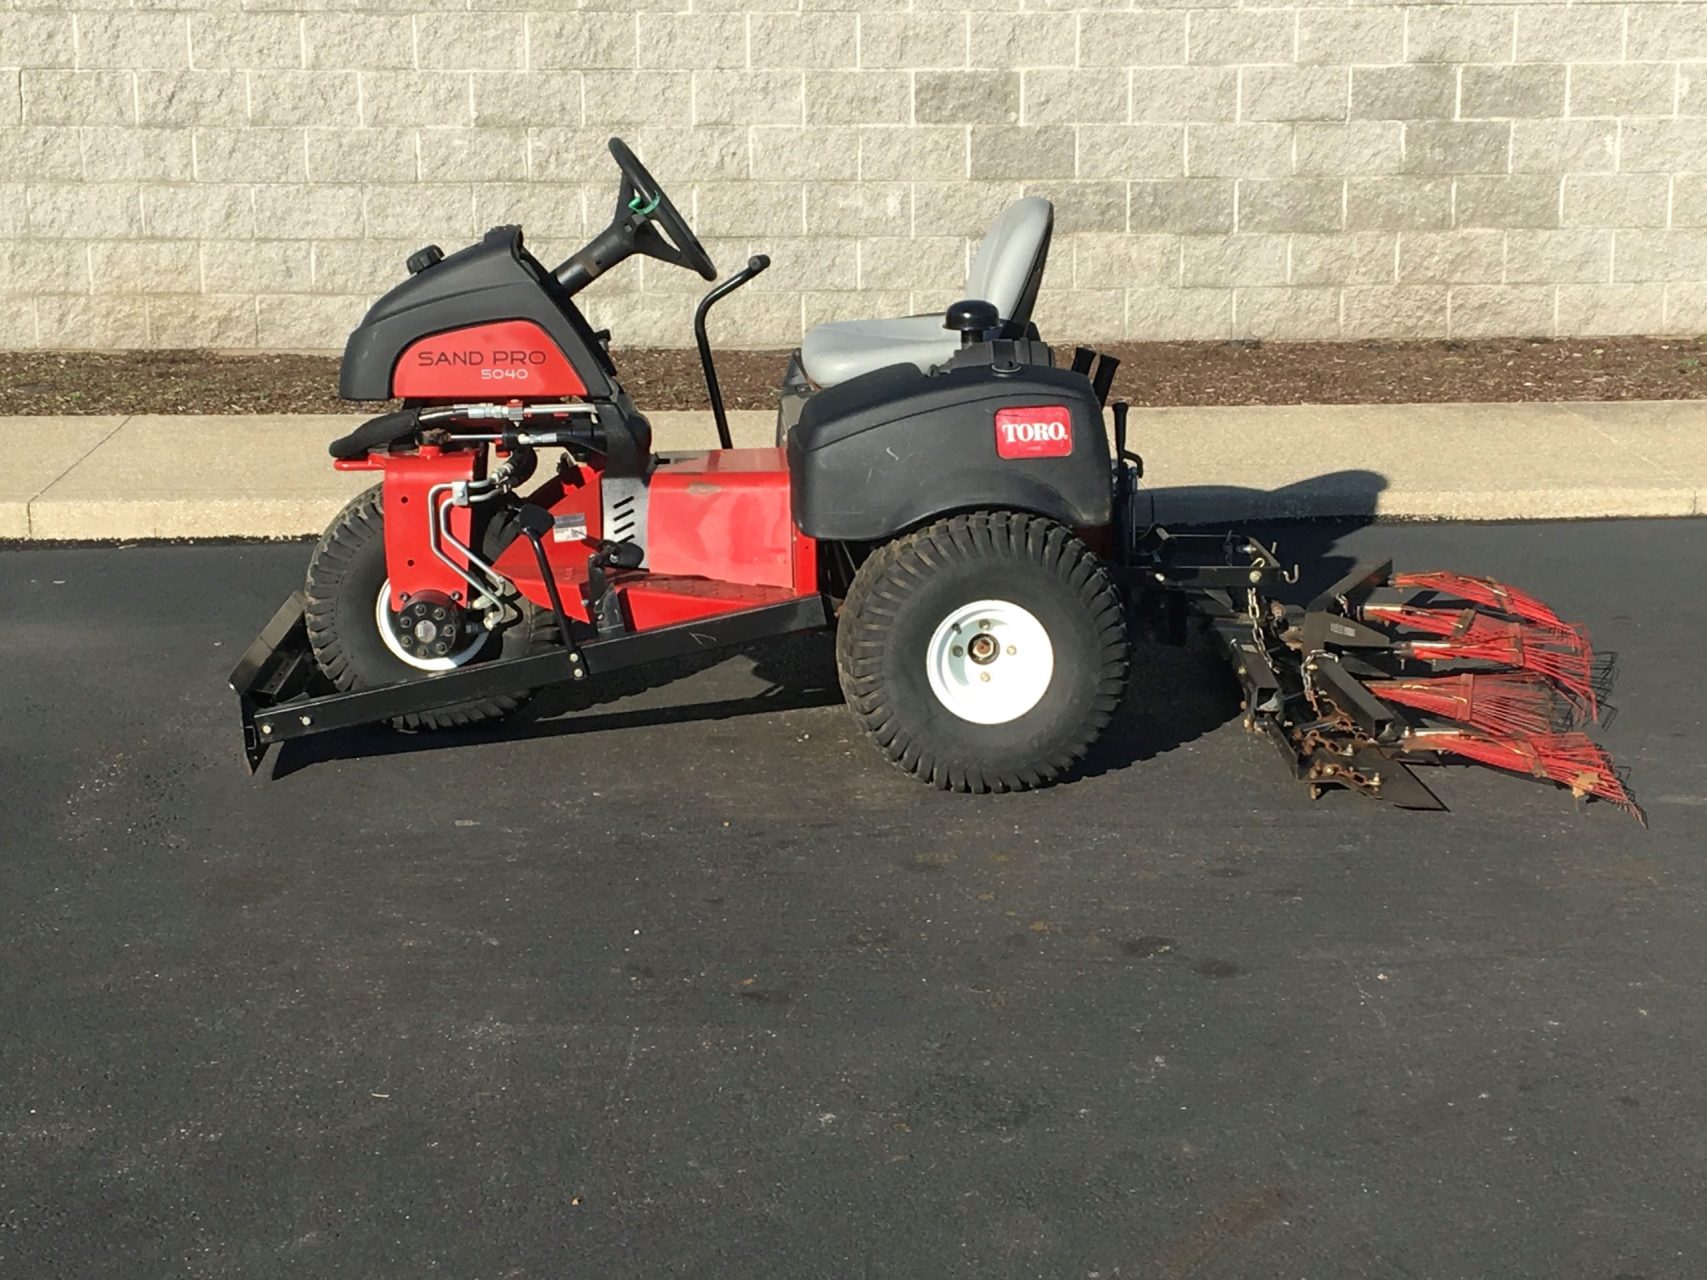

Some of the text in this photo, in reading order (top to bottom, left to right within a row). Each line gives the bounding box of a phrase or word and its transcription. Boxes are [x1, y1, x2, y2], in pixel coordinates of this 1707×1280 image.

[418, 350, 547, 366] SAND PRO
[480, 368, 529, 380] 5040
